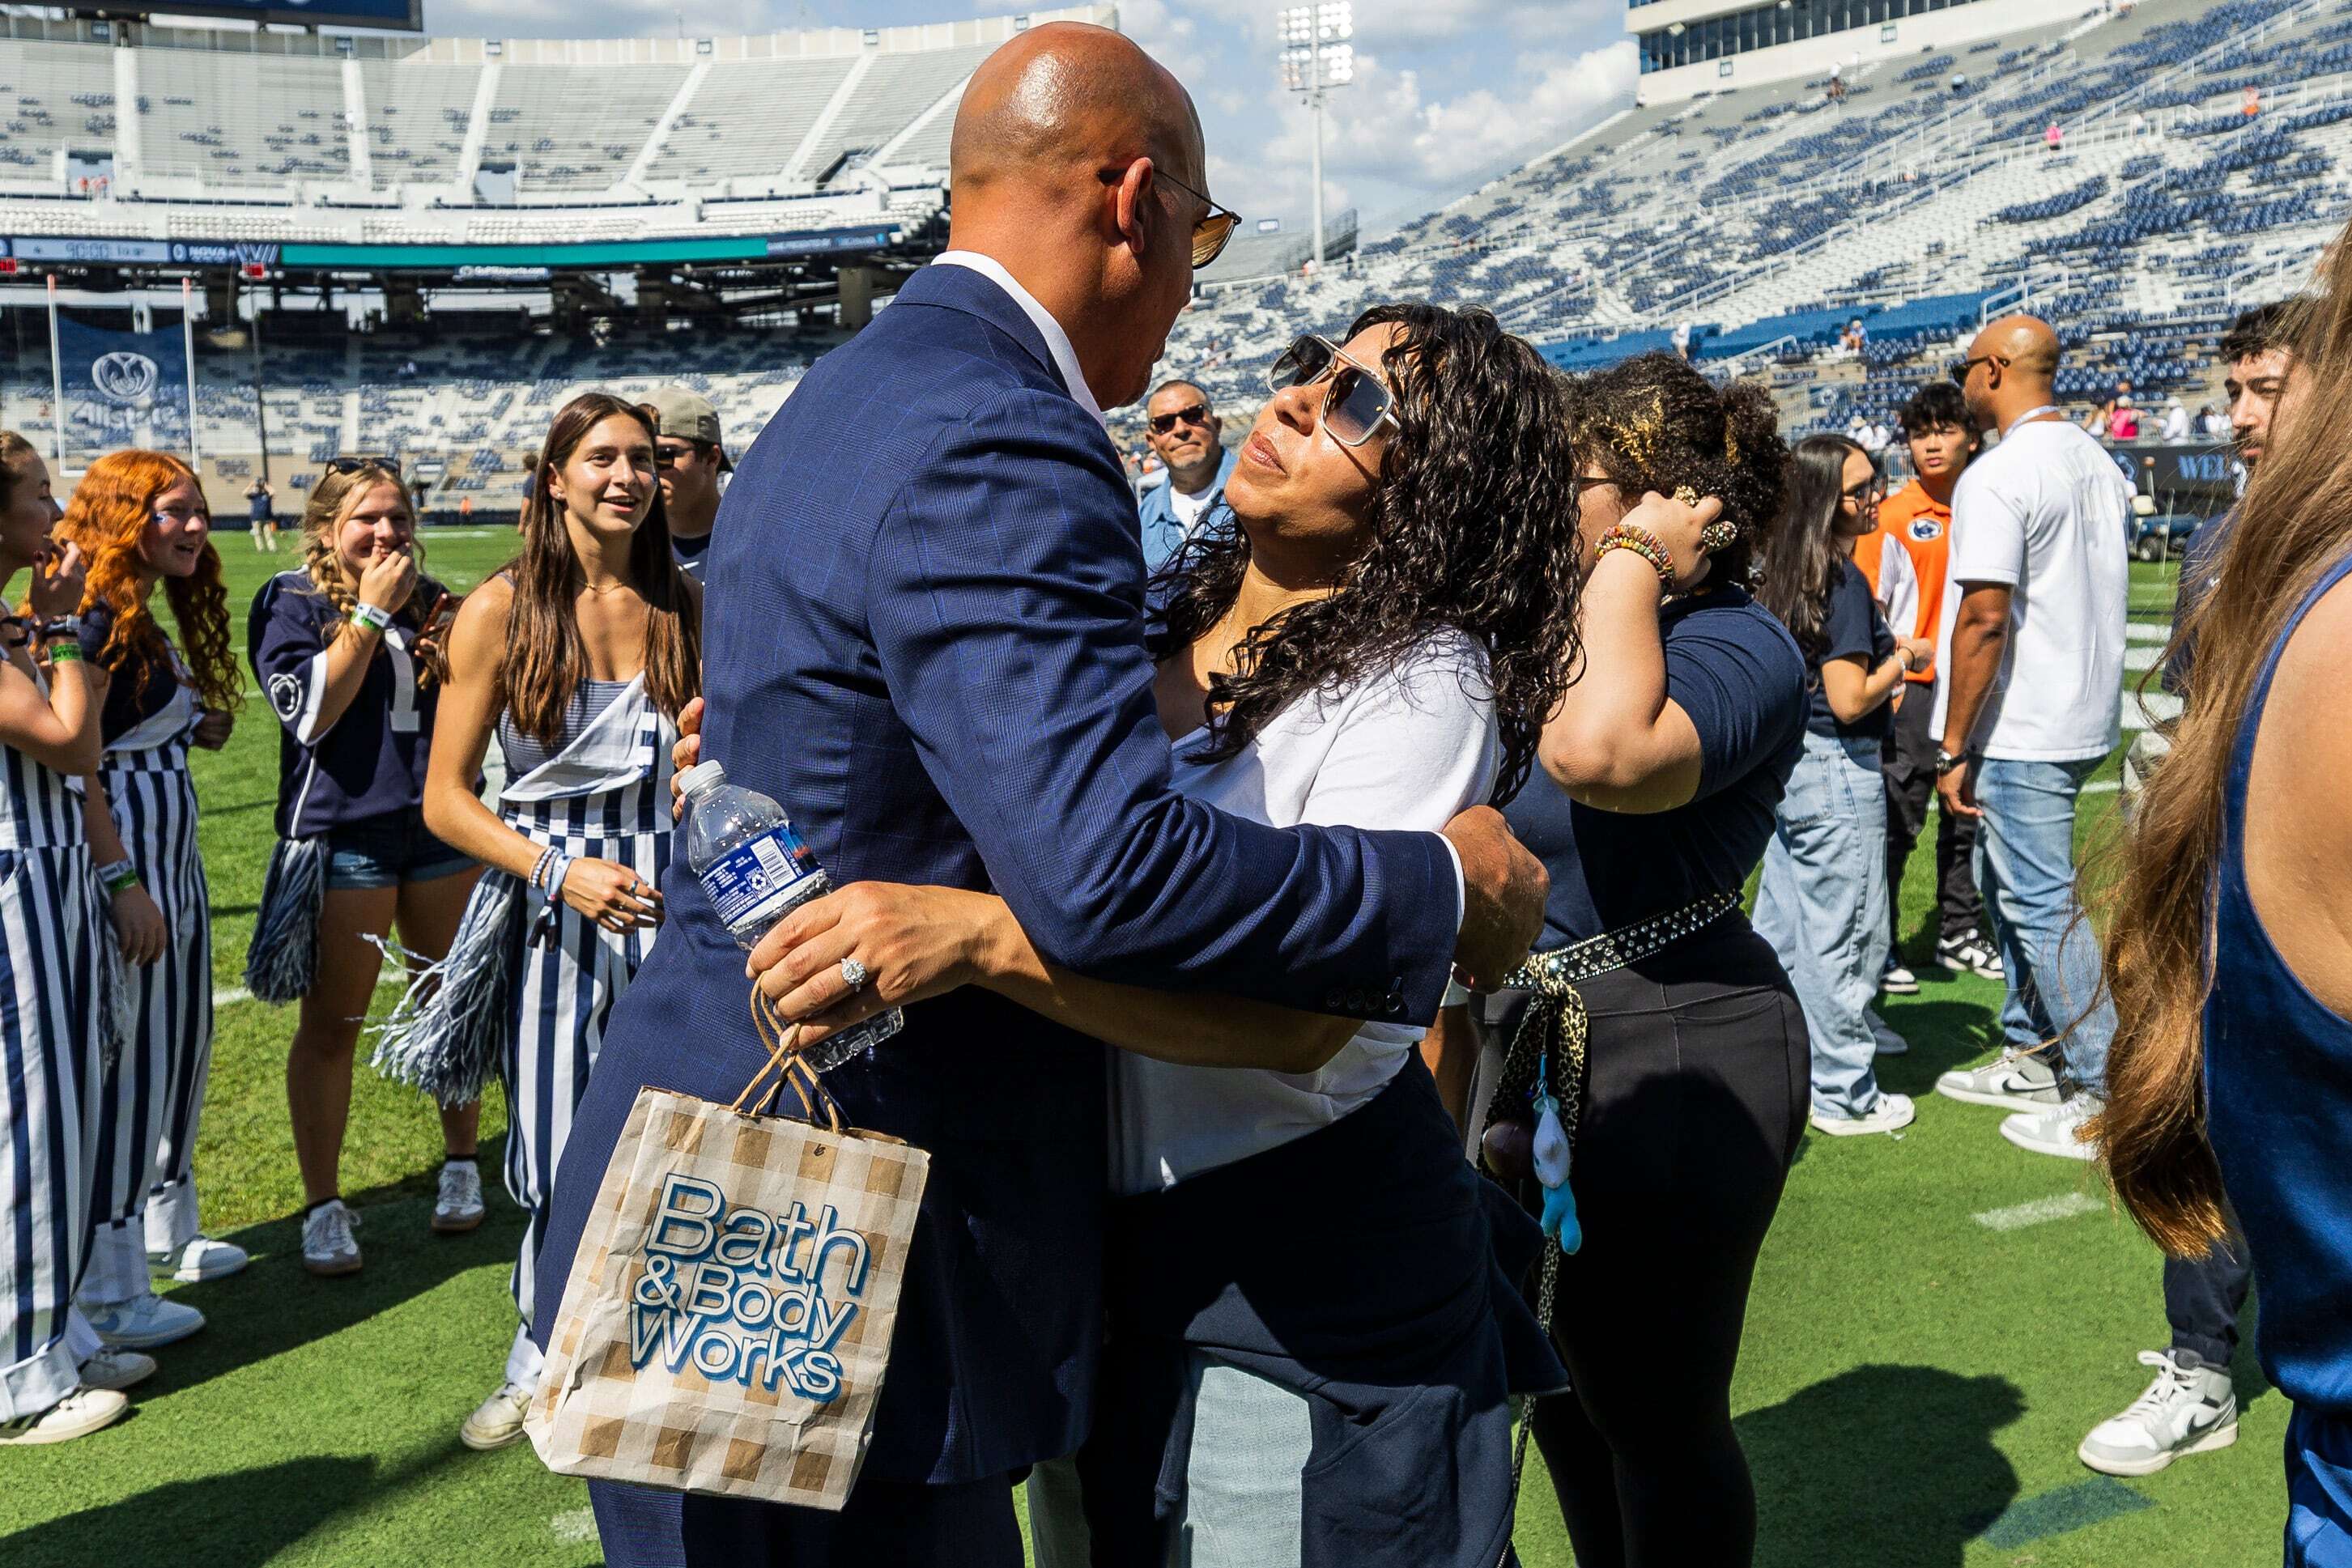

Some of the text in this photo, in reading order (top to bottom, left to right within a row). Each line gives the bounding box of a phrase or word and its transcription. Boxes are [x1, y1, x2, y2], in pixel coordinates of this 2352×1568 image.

[645, 1172, 871, 1297] Bath
[629, 1302, 844, 1404] Works
[634, 1255, 858, 1353] & Body
